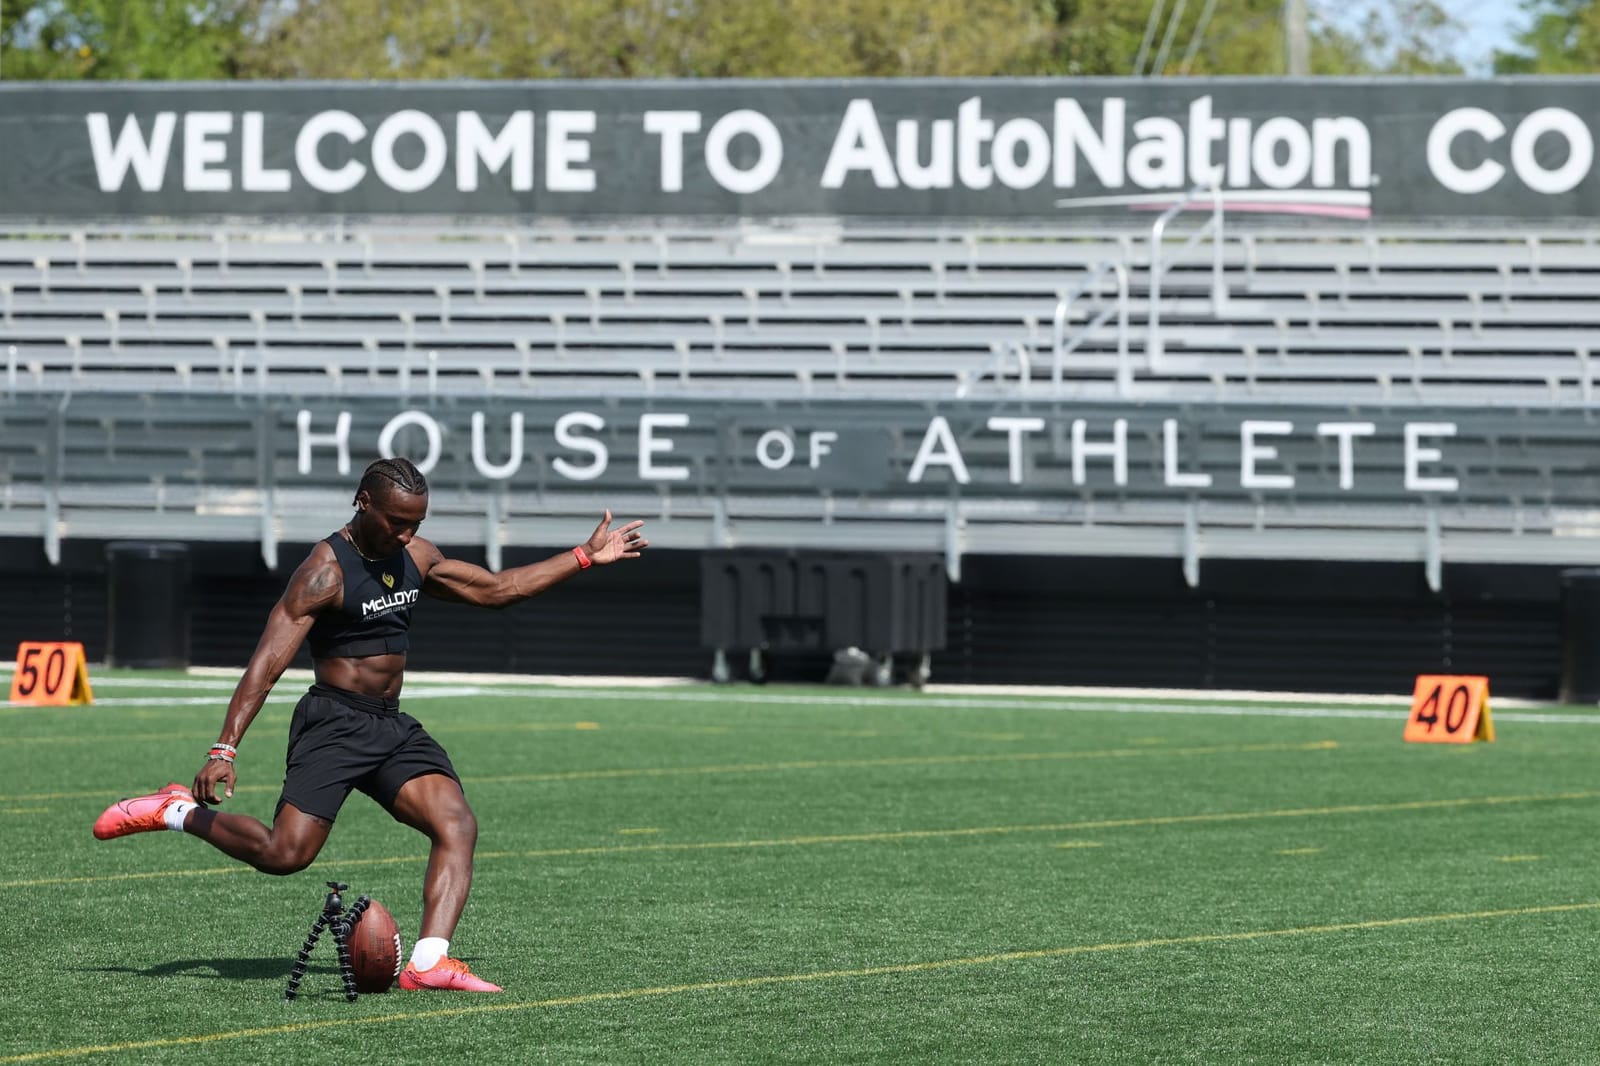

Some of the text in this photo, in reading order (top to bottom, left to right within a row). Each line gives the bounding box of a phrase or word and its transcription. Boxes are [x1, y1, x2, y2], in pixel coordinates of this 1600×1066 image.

[86, 110, 596, 193] WELCOME
[643, 109, 783, 194] TO
[820, 95, 1379, 190] AutoNation
[296, 409, 1459, 491] HOUSE OF ATHLETE
[18, 648, 65, 695] 50
[1416, 684, 1469, 733] 40
